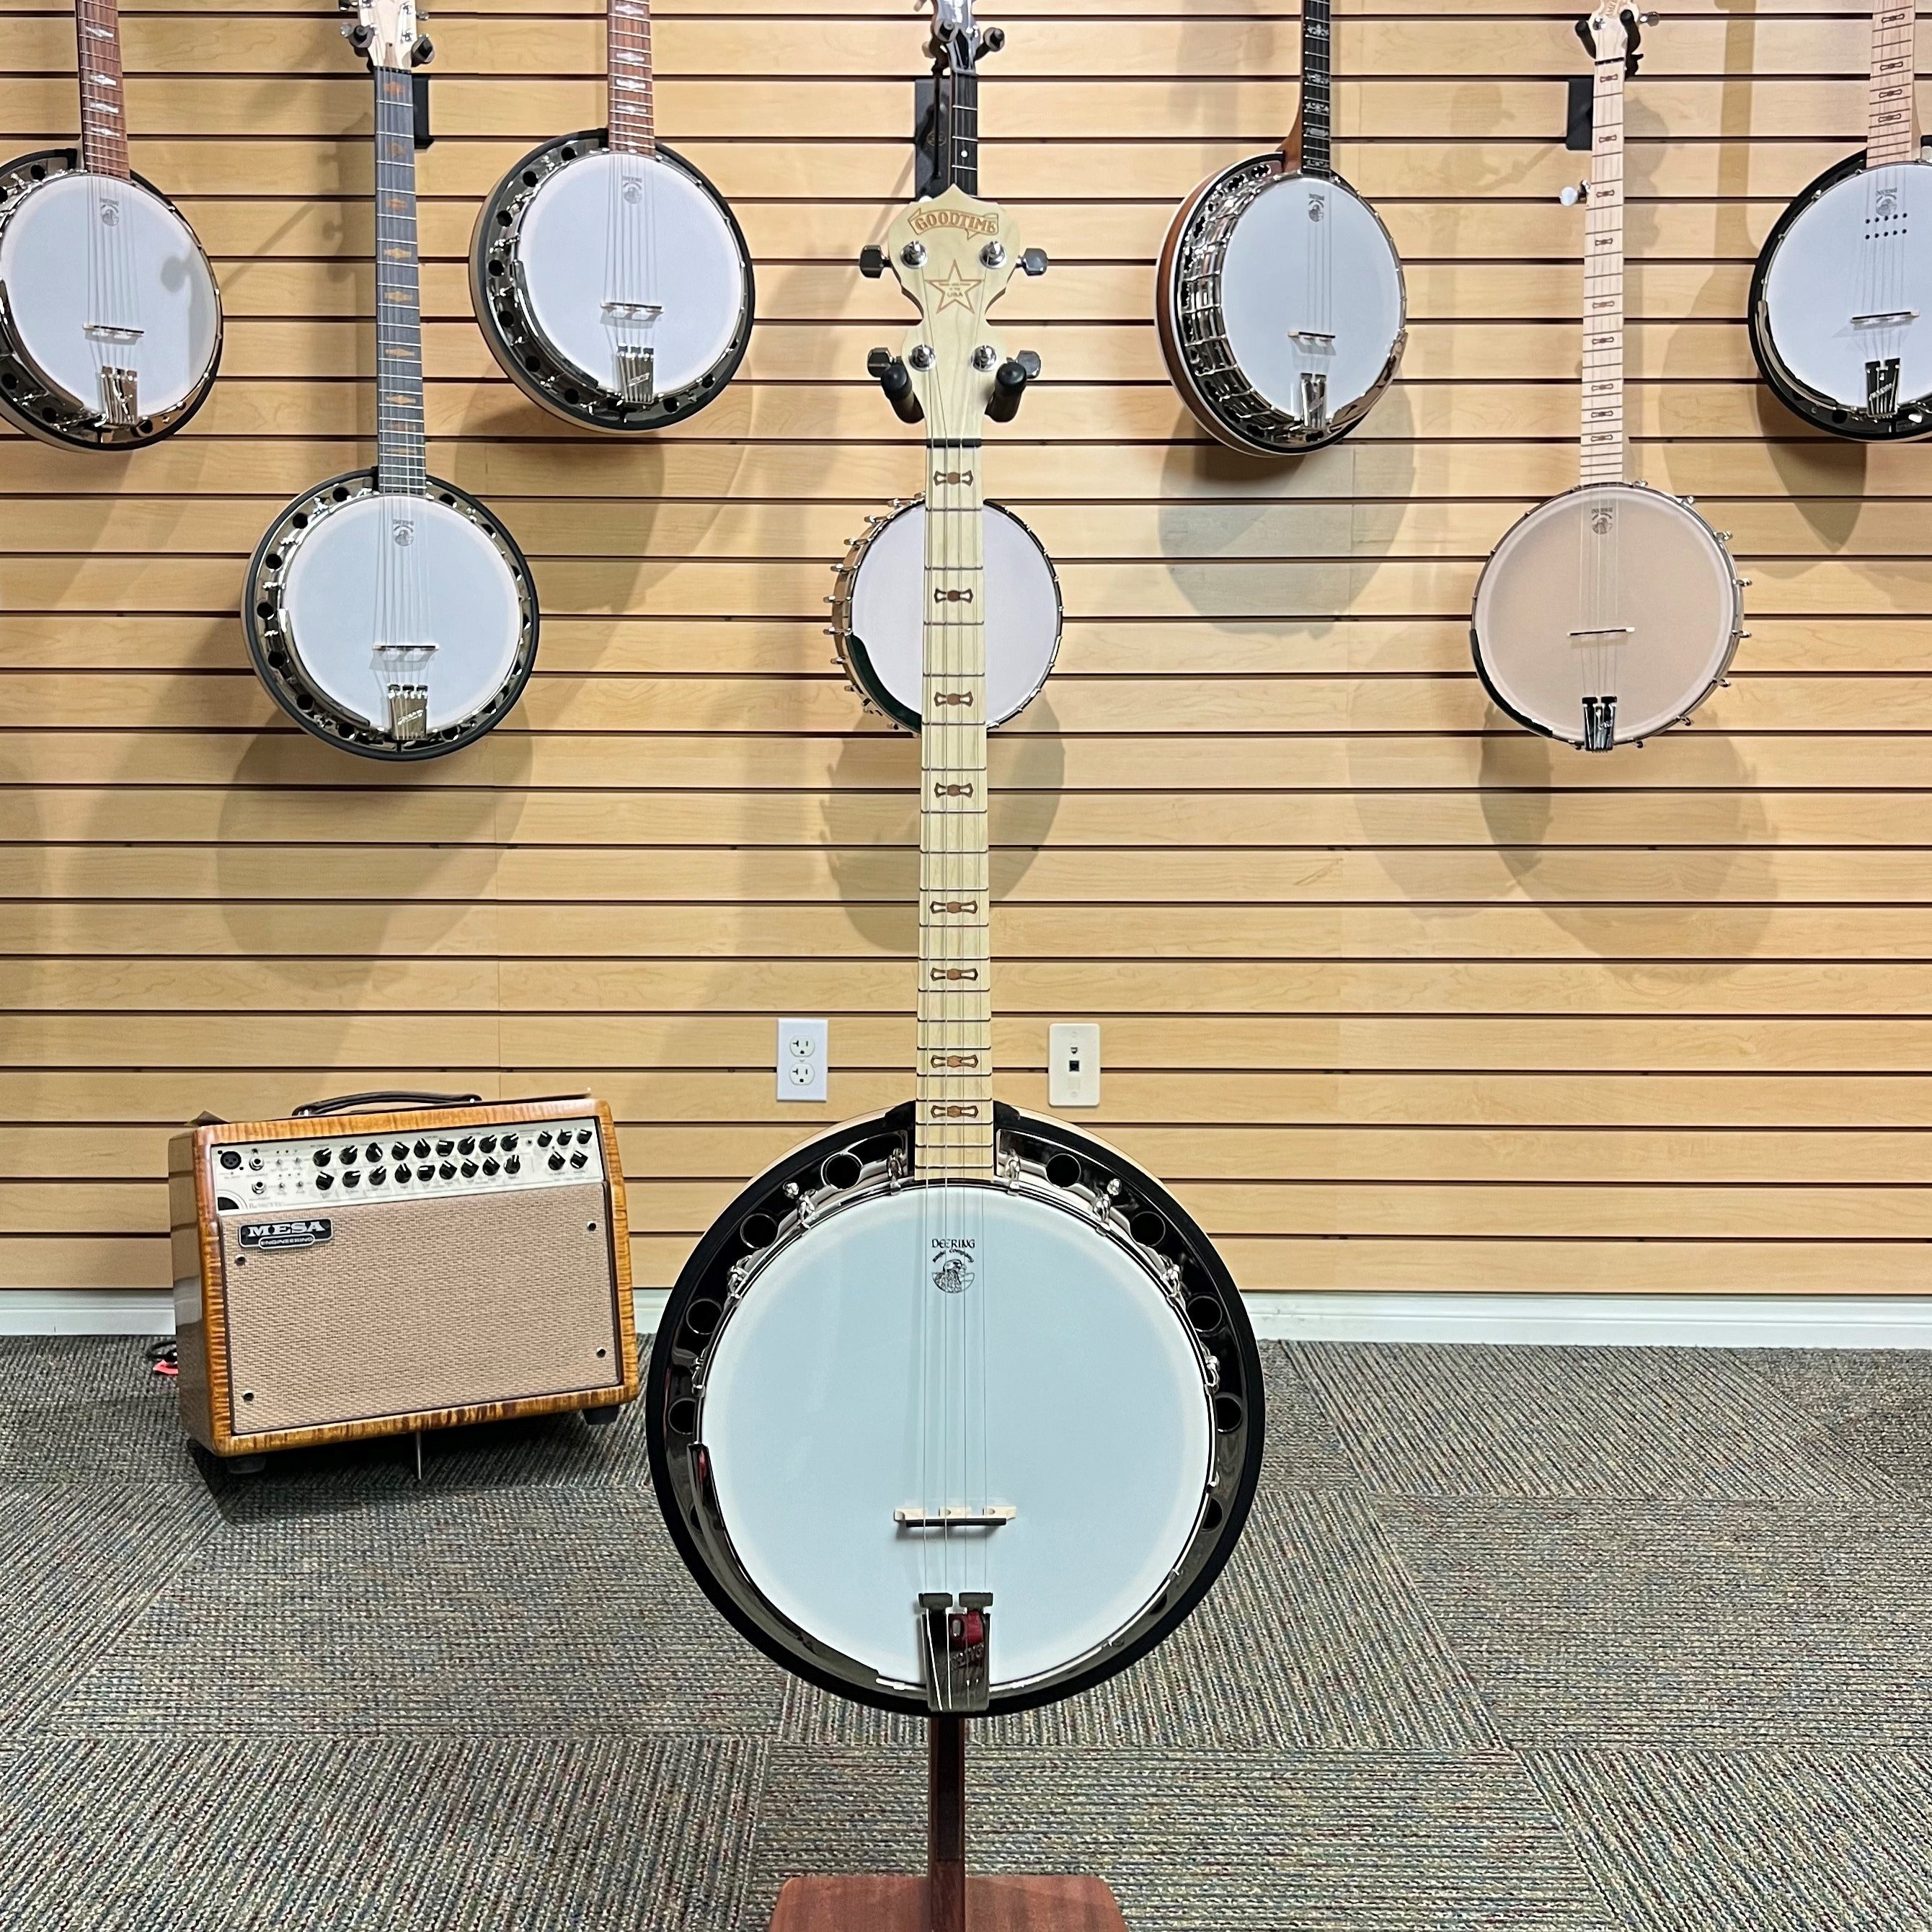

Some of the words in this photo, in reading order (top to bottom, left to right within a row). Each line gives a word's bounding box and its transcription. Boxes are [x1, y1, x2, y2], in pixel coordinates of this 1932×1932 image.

[915, 211, 996, 233] GOODTIME
[247, 1221, 326, 1237] MESA
[260, 1236, 313, 1246] ENGINEERING
[931, 1238, 975, 1249] DEERING
